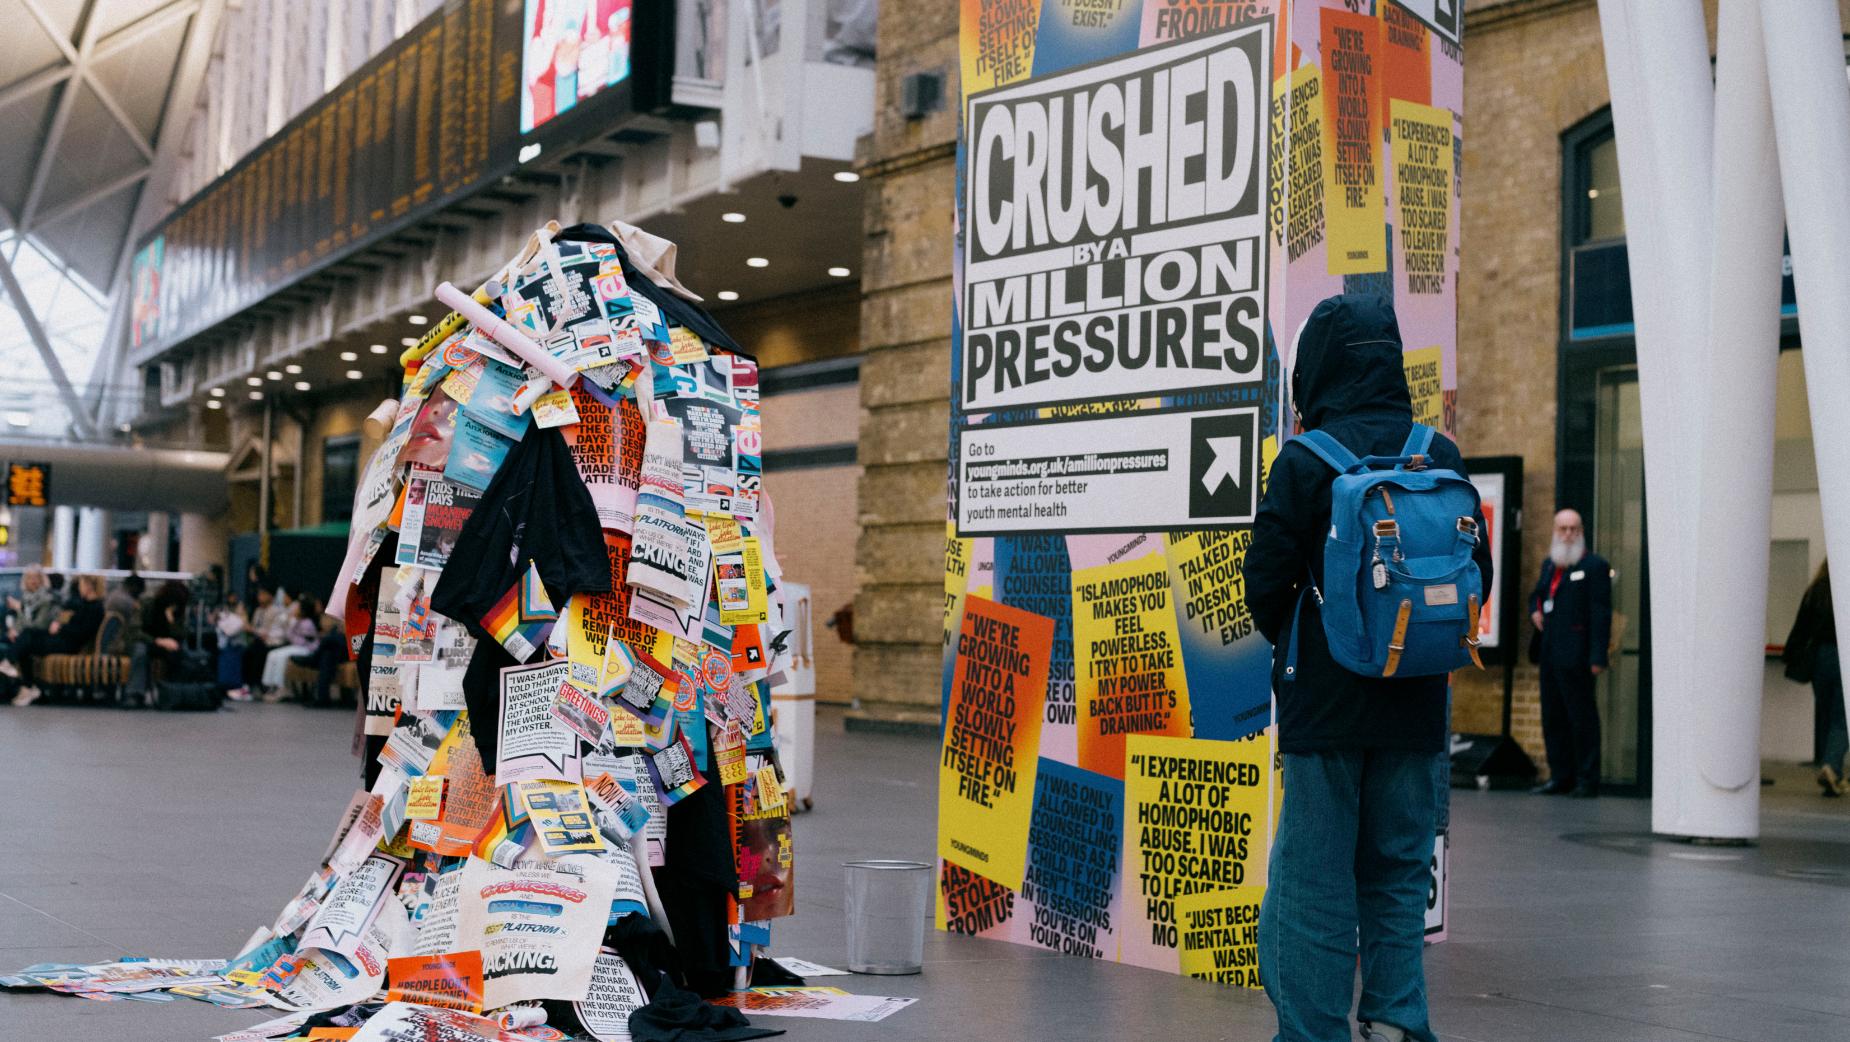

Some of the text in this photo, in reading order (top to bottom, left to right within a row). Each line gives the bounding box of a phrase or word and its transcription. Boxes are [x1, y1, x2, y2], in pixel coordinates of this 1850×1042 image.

[980, 8, 1036, 54] SETTING
[1156, 6, 1221, 39] FROM
[1333, 26, 1364, 51] "WE'RE
[977, 36, 1018, 76] ITSELF
[1331, 49, 1372, 75] GROWING
[1339, 73, 1366, 97] INTO A
[1338, 95, 1368, 119] WORLD
[1337, 118, 1370, 141] SLOWLY
[1402, 119, 1450, 147] EXPERIENCED
[974, 46, 1256, 257] CRUSHED
[1337, 141, 1372, 163] SETTING
[1408, 142, 1438, 166] A LOT OF
[1335, 163, 1374, 186] ITSELF ON
[1399, 163, 1447, 188] HOMOPHOBIC
[1401, 185, 1447, 209] ABUSE. I WAS
[1401, 209, 1446, 230] TOO SCARED
[1073, 237, 1129, 266] BY A
[1401, 230, 1447, 252] TO LEAVE MY
[1405, 252, 1445, 273] HOUSE FOR
[973, 239, 1253, 328] MILLION
[966, 296, 1260, 404] PRESSURES
[575, 425, 635, 438] 'THE GOOD
[580, 415, 610, 424] YOUR
[569, 445, 617, 454] MEAN IT
[577, 434, 610, 444] DAYS'
[968, 443, 995, 457] Go to
[573, 454, 605, 464] EXIST
[581, 465, 631, 477] MADE UP
[967, 453, 1166, 480] youngminds.org.uk/amillionpressures
[428, 493, 453, 506] DAYS
[429, 482, 454, 494] KIDS
[968, 480, 1088, 498] to take action for better
[967, 502, 1067, 523] youth mental health
[1107, 533, 1147, 565] YOUNGMINDS
[1179, 543, 1230, 581] TALKED
[1188, 557, 1242, 598] IN 'YOUR
[1093, 591, 1165, 620] MAKES YOU
[1186, 578, 1242, 620] DOESN'T
[966, 612, 1020, 649] "WE'RE
[1115, 615, 1144, 635] FEEL
[1202, 612, 1214, 633] IT
[958, 633, 1030, 677] GROWING
[1091, 631, 1170, 658] POWERLESS.
[517, 674, 536, 684] WAS
[537, 667, 569, 679] ALWAYS
[966, 659, 1014, 696] INTO A
[1090, 650, 1174, 678] I TRY TO TAKE
[509, 678, 551, 693] TOLD THAT
[509, 688, 543, 702] WORKED
[1098, 671, 1166, 696] MY POWER
[520, 695, 551, 708] SCHOOL
[559, 683, 609, 726] GREETINGS!
[962, 681, 1015, 719] WORLD
[1090, 689, 1177, 717] BACK BUT IT'S
[506, 722, 552, 736] MY OYSTER.
[523, 713, 552, 724] WORLD
[955, 703, 1016, 744] SLOWLY
[951, 725, 1014, 768] SETTING
[944, 745, 1016, 794] ITSELF ON
[1131, 755, 1260, 787] "I EXPERIENCED
[595, 775, 623, 804] NOW
[1050, 776, 1078, 800] WAS
[1081, 786, 1113, 811] ONLY
[1159, 781, 1230, 808] A LOT OF
[1039, 792, 1114, 831] ALLOWED 10
[1139, 802, 1251, 836] HOMOPHOBIC
[1032, 809, 1117, 853] COUNSELLING
[1140, 826, 1248, 861] ABUSE. I WAS
[950, 838, 989, 863] YOUNGMINDS
[1029, 827, 1117, 874] SESSIONS AS A
[1031, 847, 1111, 890] CHILD. IF YOU
[1142, 850, 1244, 884] TOO SCARED
[1026, 865, 1113, 909] AREN'T 'FIXED'
[1140, 873, 1161, 897] TO
[1021, 881, 1113, 935] IN 10 SESSIONS,
[1185, 908, 1223, 930] "JUST
[501, 922, 560, 934] PLATFORM
[1030, 922, 1061, 951] YOUR
[1034, 905, 1097, 945] YOU'RE ON
[1184, 927, 1241, 951] MENTAL
[608, 976, 628, 985] HARD
